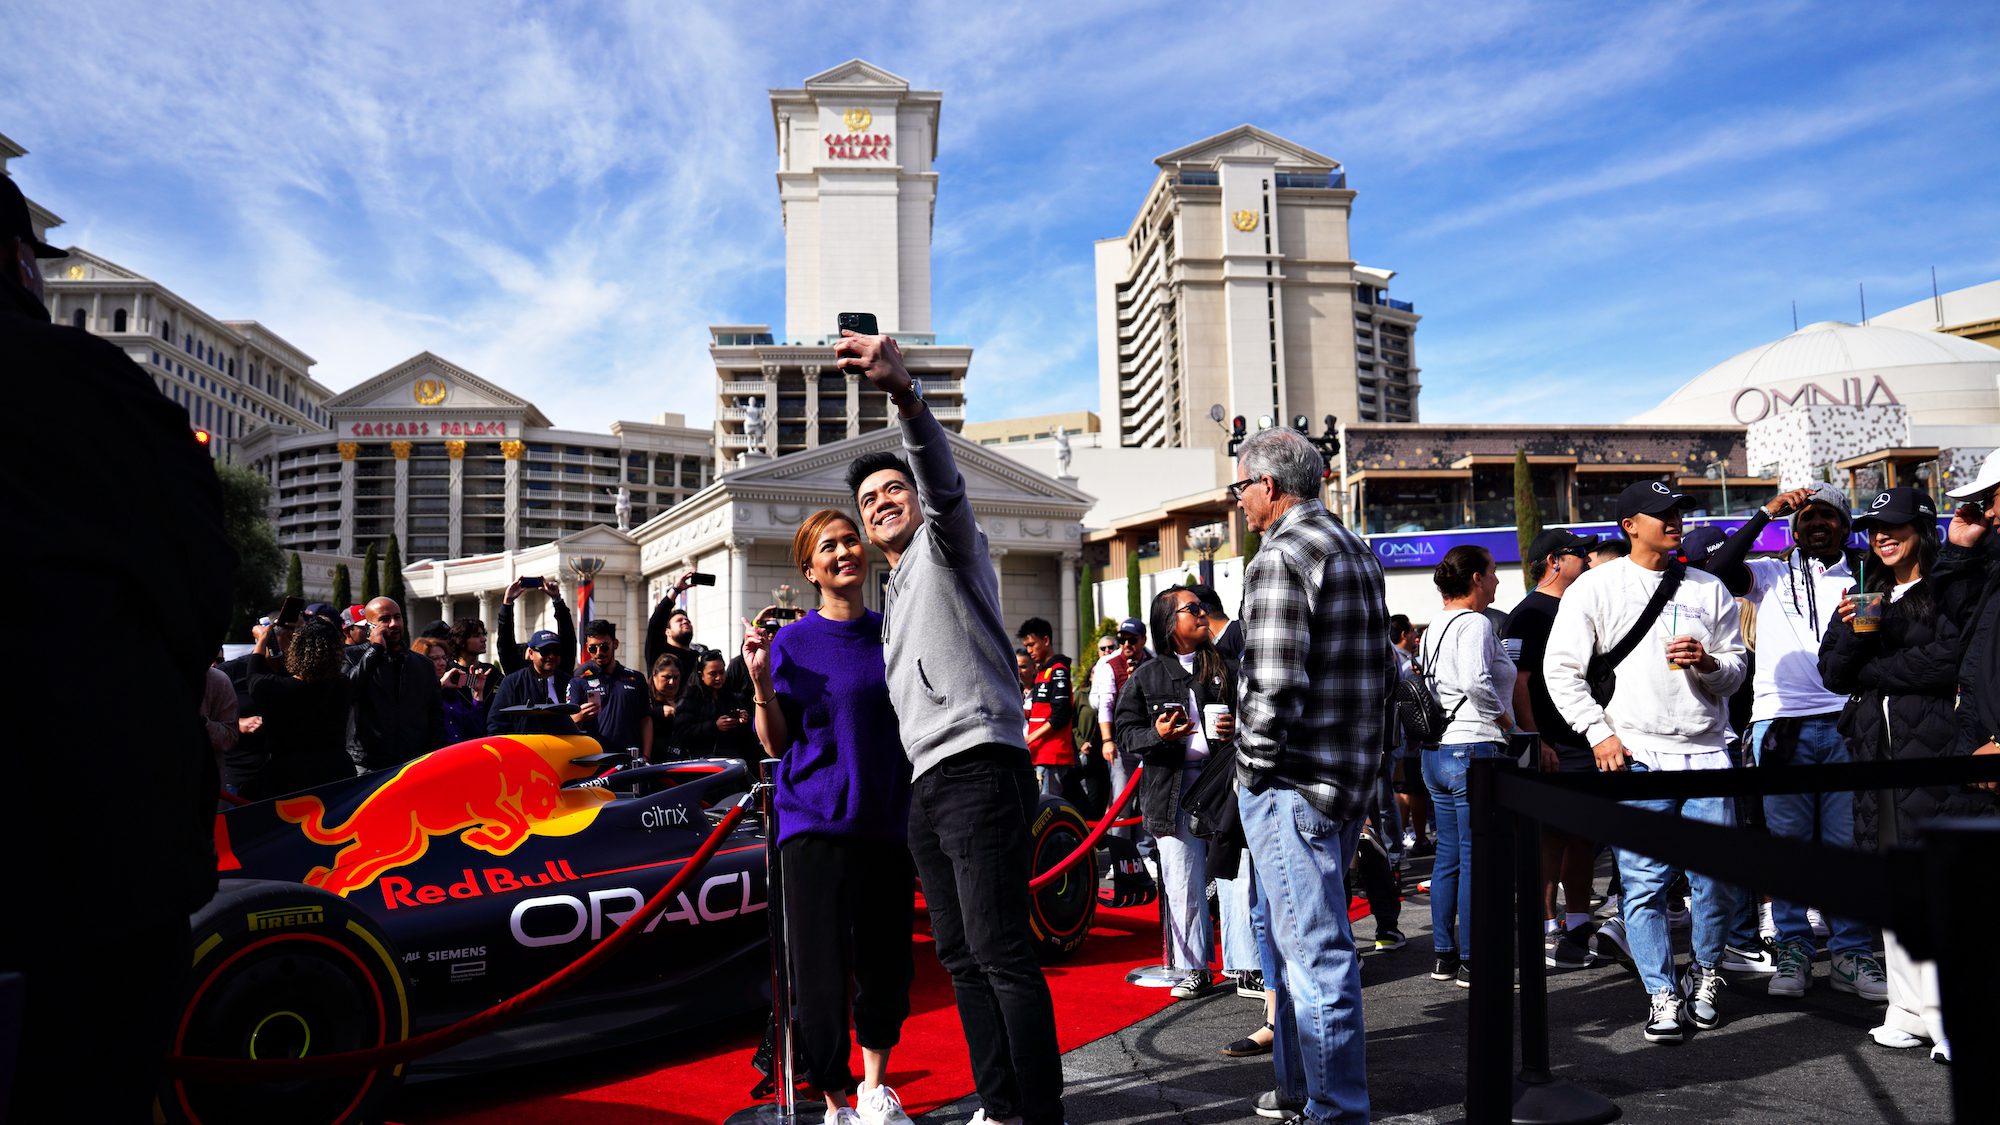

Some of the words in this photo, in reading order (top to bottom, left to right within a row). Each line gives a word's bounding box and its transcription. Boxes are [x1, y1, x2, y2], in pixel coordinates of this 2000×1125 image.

[824, 134, 891, 146] CAESARS
[828, 147, 888, 160] PALACE
[1731, 374, 1900, 425] OMNIA
[351, 421, 429, 437] CAESARS
[440, 420, 506, 437] PALACE
[1379, 541, 1435, 557] OMNIA
[641, 803, 689, 829] citrix
[1119, 857, 1144, 875] Mobil
[379, 868, 482, 911] Red
[483, 858, 580, 894] Bull
[509, 870, 769, 948] ORACL
[246, 905, 324, 932] PIRELLI
[427, 945, 487, 962] SIEMENS
